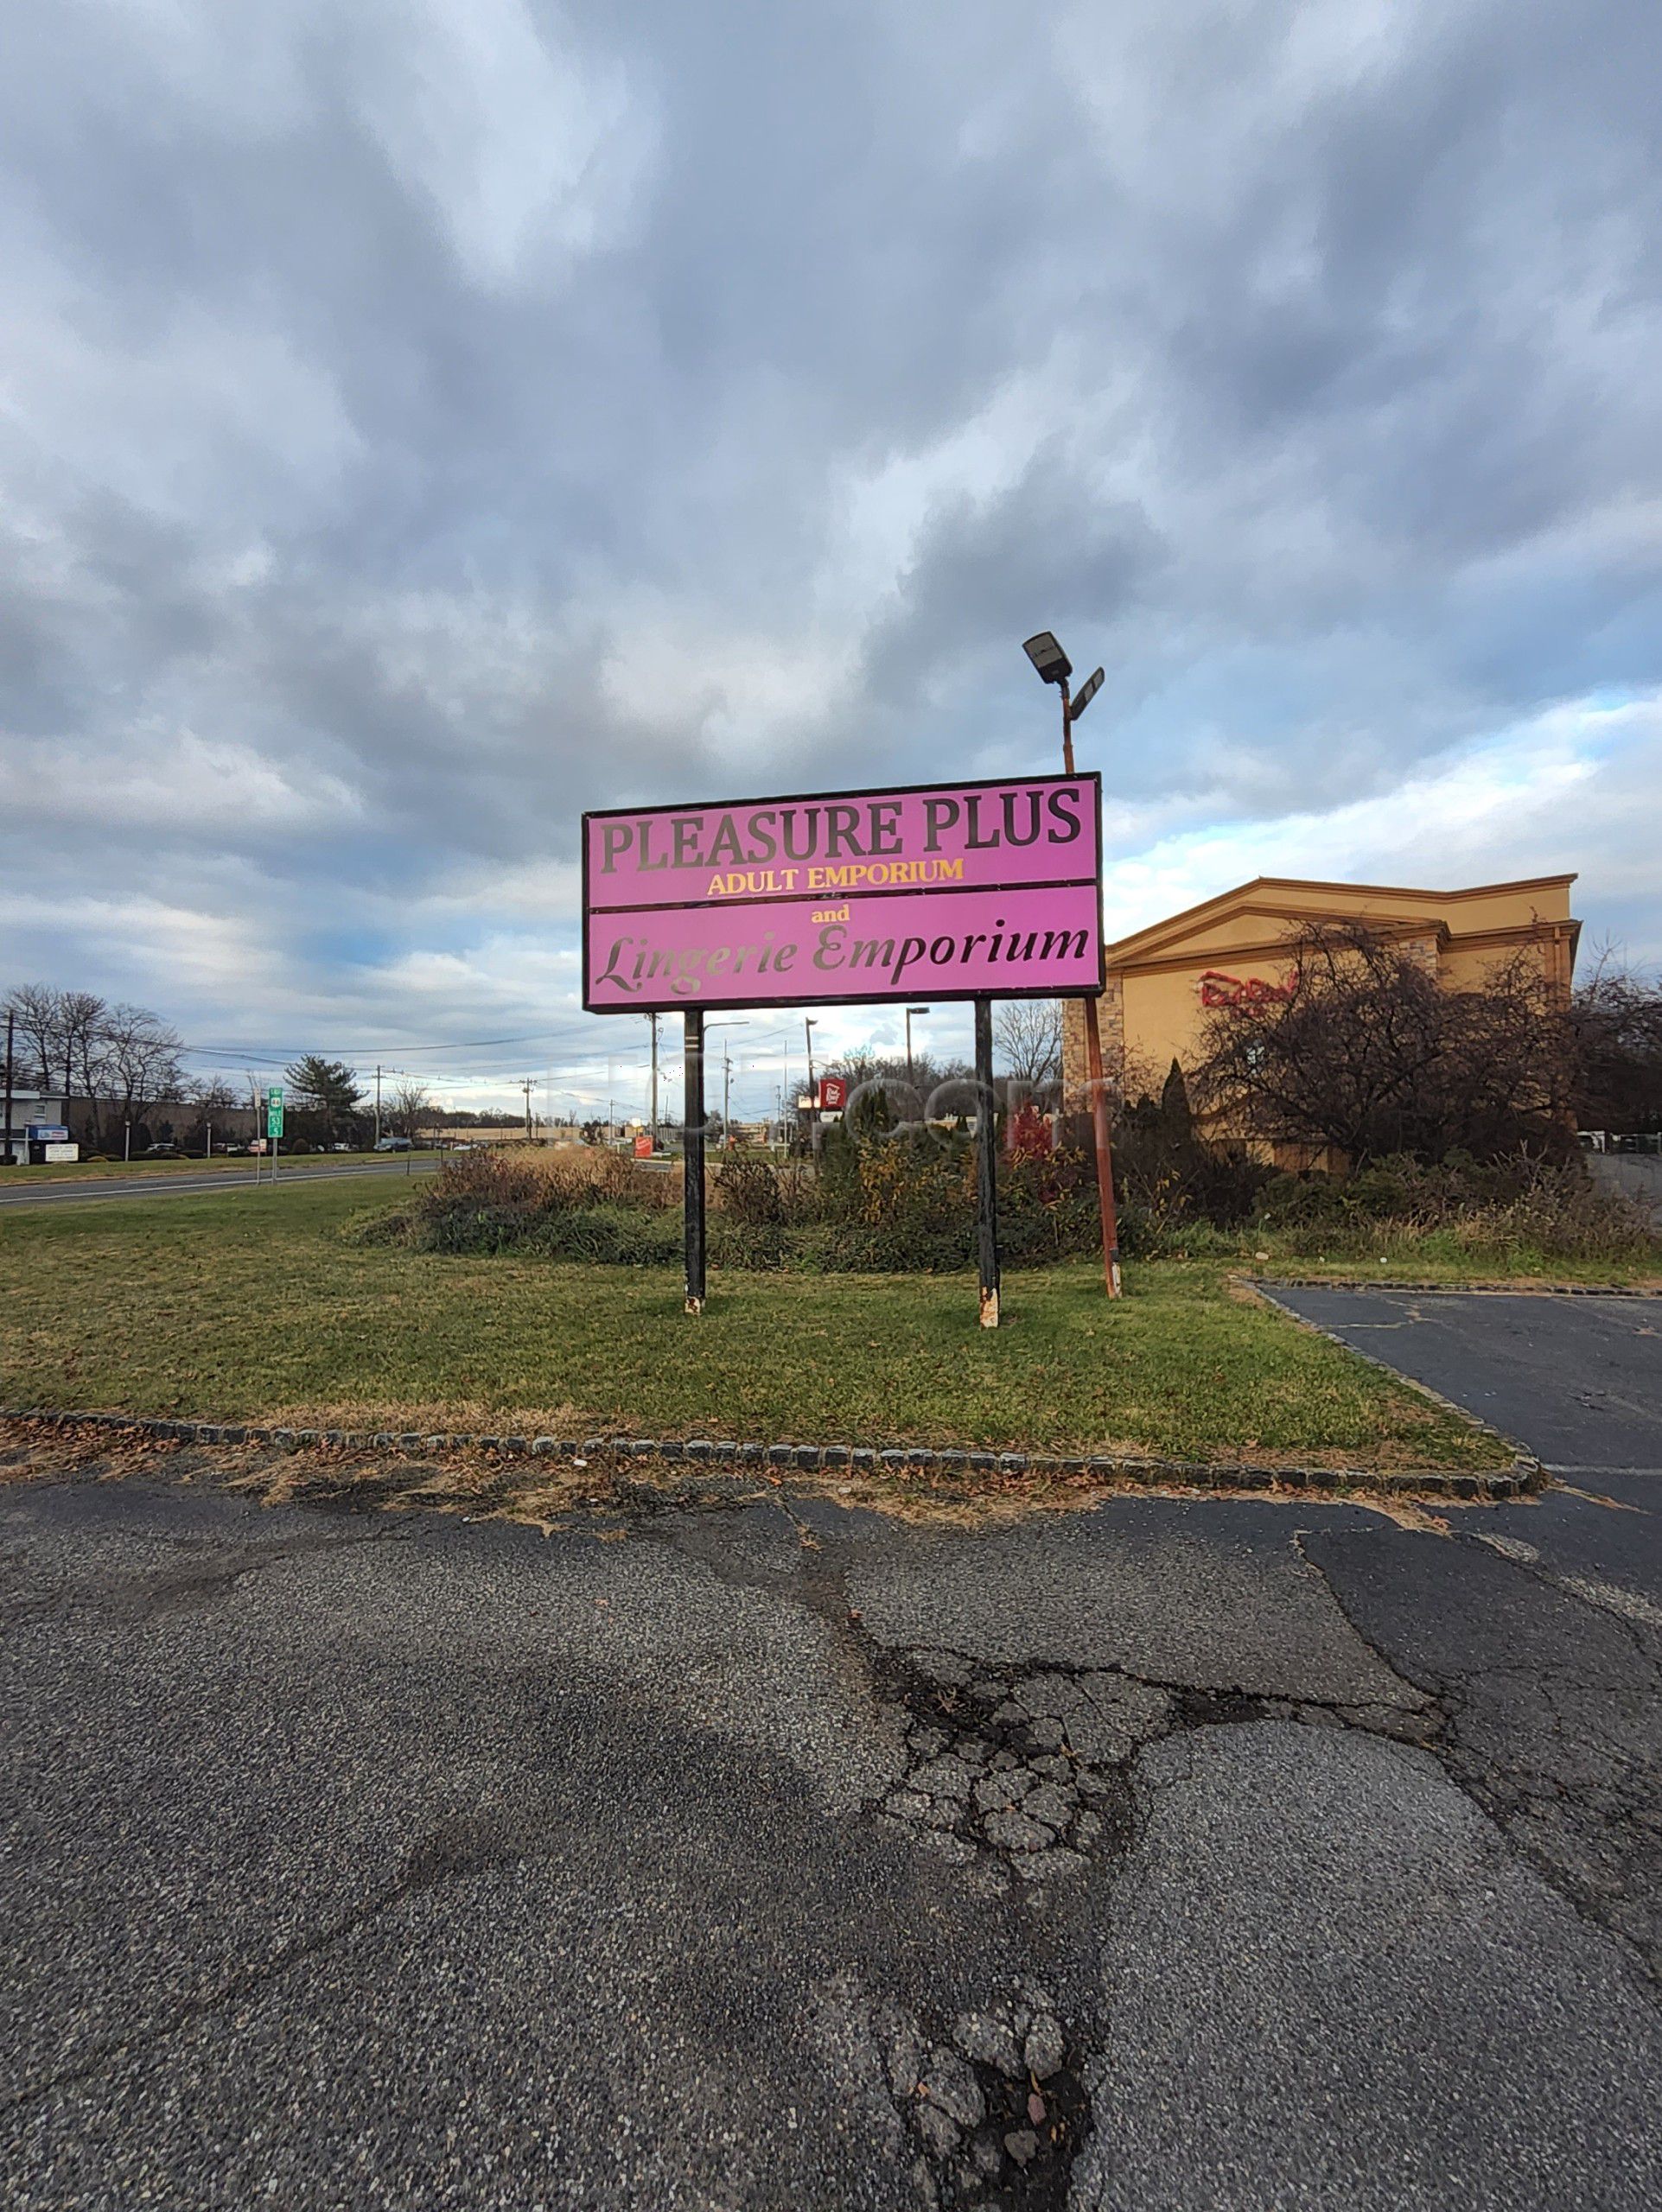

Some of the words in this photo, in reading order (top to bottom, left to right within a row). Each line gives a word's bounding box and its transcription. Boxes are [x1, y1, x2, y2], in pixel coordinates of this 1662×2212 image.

[600, 801, 904, 874] PLEASURE
[921, 788, 1082, 852] PLUS
[706, 868, 799, 896] ADULT
[807, 858, 964, 890] EMPORIUM
[811, 904, 850, 924] and
[595, 931, 798, 995] Lingerie
[812, 919, 1089, 985] Emporium
